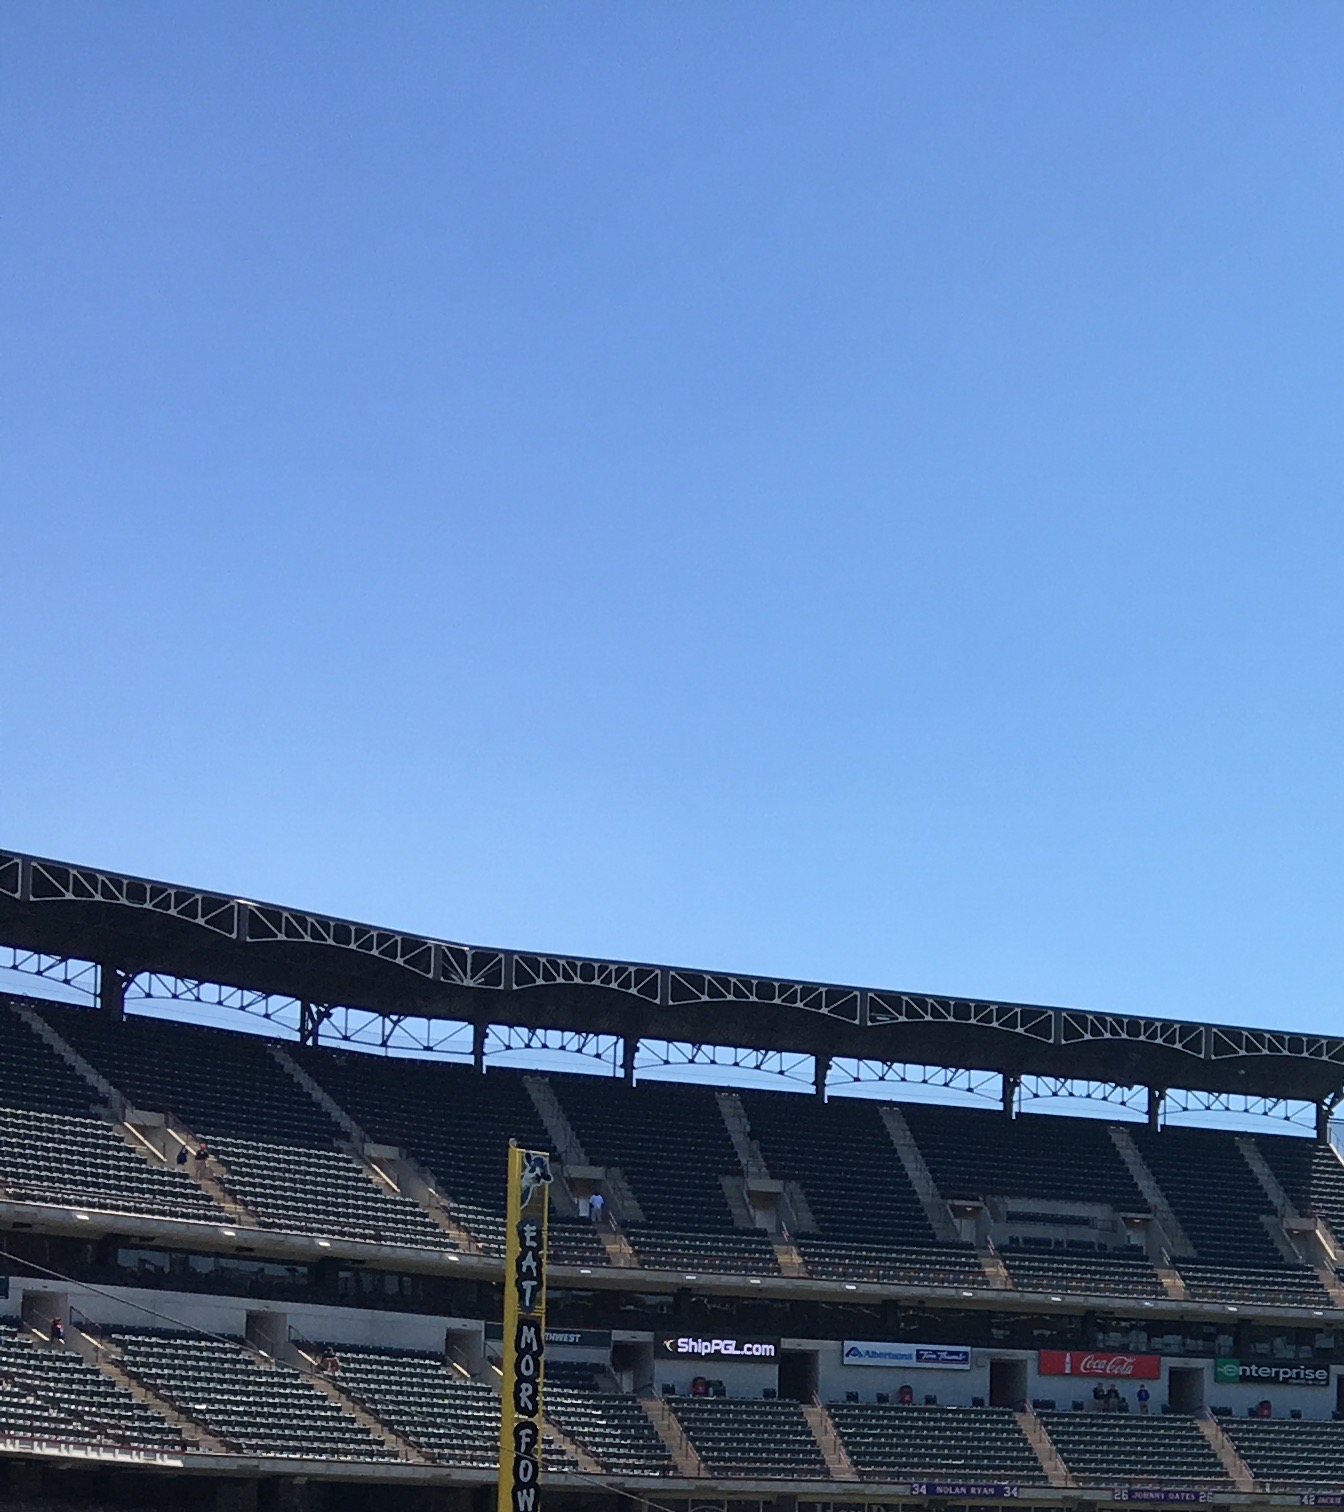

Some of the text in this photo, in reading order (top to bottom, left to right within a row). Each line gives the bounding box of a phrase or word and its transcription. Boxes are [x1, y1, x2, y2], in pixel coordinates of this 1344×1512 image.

[677, 1338, 775, 1357] ShipPGL.com
[518, 1325, 538, 1412] MOR
[1224, 1364, 1329, 1382] enterprise
[911, 1483, 1018, 1498] 34 NOLAN RYAN 34
[1113, 1489, 1214, 1503] 26 JOHNNY OATES 26
[1301, 1494, 1316, 1505] 42
